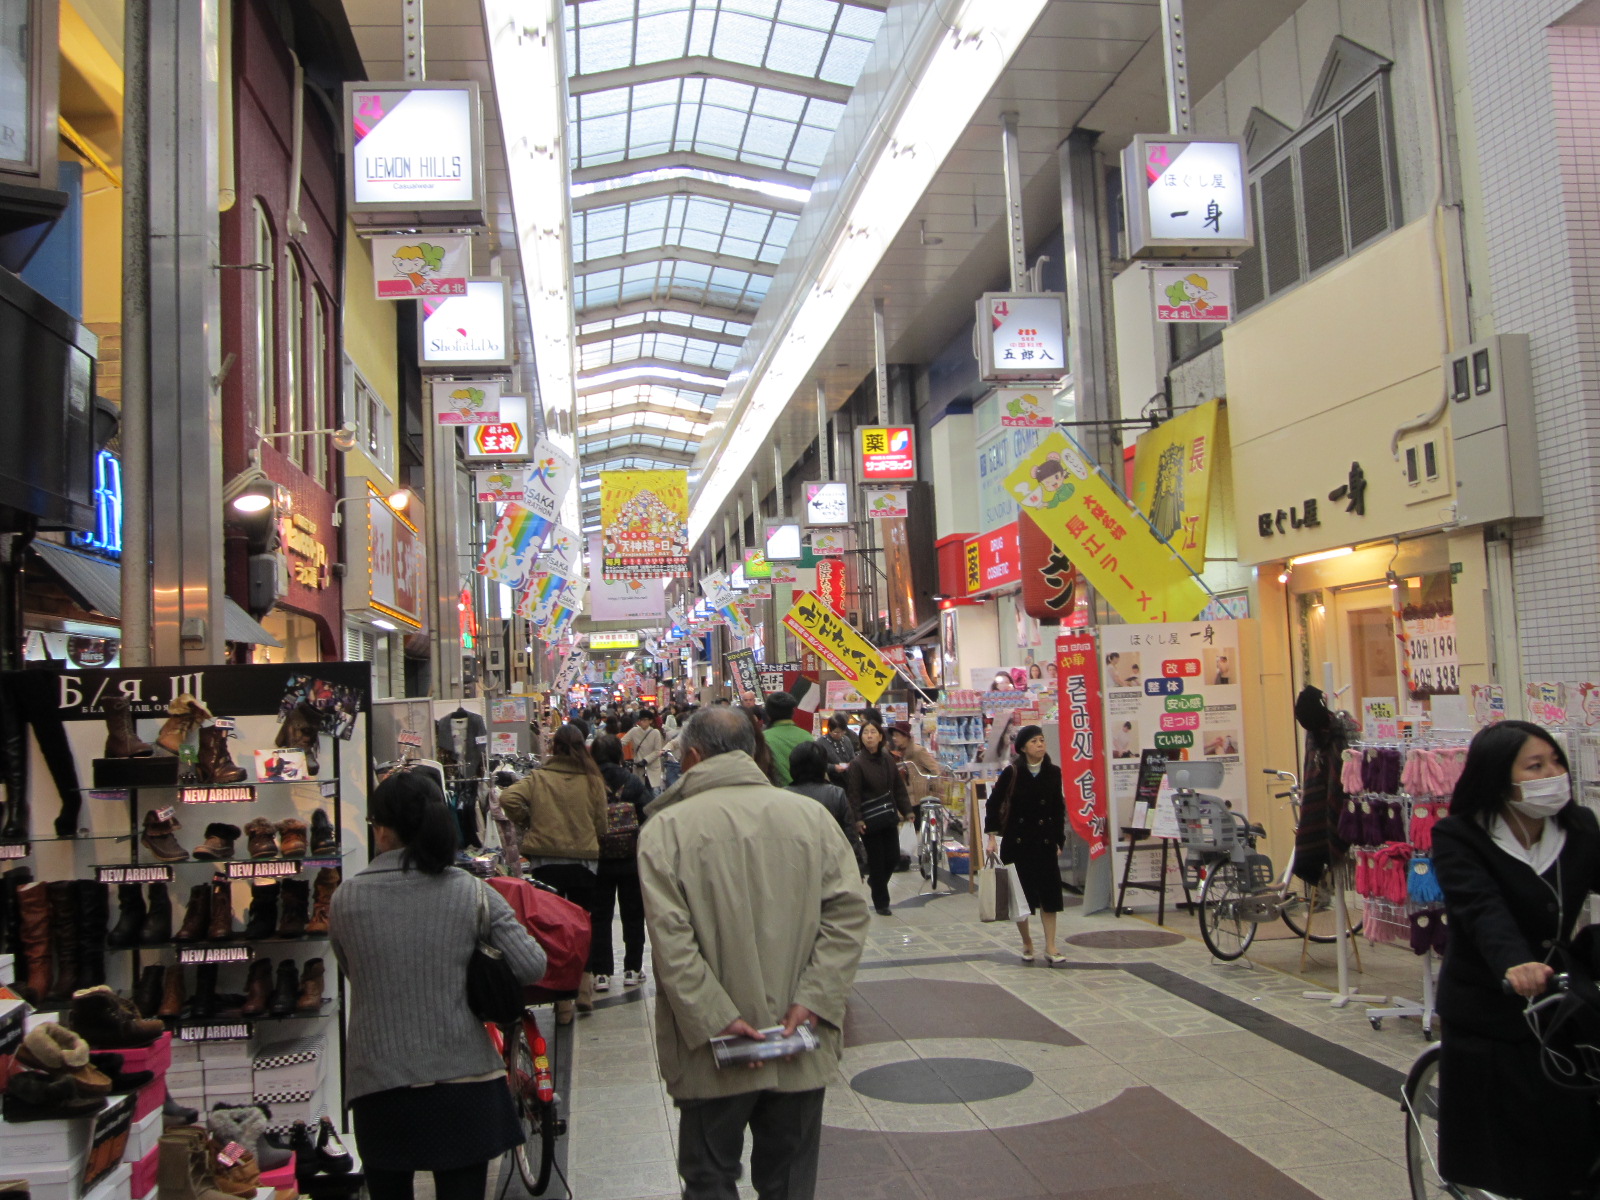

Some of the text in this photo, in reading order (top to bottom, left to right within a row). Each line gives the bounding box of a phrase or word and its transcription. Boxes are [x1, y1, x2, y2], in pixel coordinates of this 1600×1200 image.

[366, 155, 461, 179] LEMON HILLS
[1164, 174, 1225, 189] ほぐし屋
[1170, 199, 1223, 233] 一身
[426, 283, 464, 294] 天4北
[1160, 310, 1190, 319] 天4北
[484, 434, 515, 450] 王将
[866, 434, 884, 452] 薬
[865, 460, 912, 471] サンドラッグ
[523, 498, 553, 517] ARATHON
[1083, 495, 1127, 541] 大阪名物
[1258, 499, 1320, 537] ほぐし屋
[621, 540, 670, 552] 天神橋の日
[990, 536, 1004, 552] DRUG
[987, 562, 1010, 580] COSMETIC
[1065, 514, 1167, 623] 長江ラーメン
[1129, 624, 1215, 646] ほぐし屋 一身
[1411, 639, 1428, 660] 30分
[1061, 653, 1086, 669] 中華
[1165, 662, 1197, 674] 改善
[1148, 681, 1179, 693] 整体
[1167, 696, 1201, 709] 安心感
[1156, 734, 1192, 746] ていねい
[183, 788, 251, 802] NEW ARRIVAL
[101, 867, 169, 882] NEW ARRIVAL
[229, 862, 297, 877] NEW ARRIVAL
[181, 948, 249, 963] NEW ARRIVAL
[181, 1024, 249, 1040] NEW ARRIVAL
